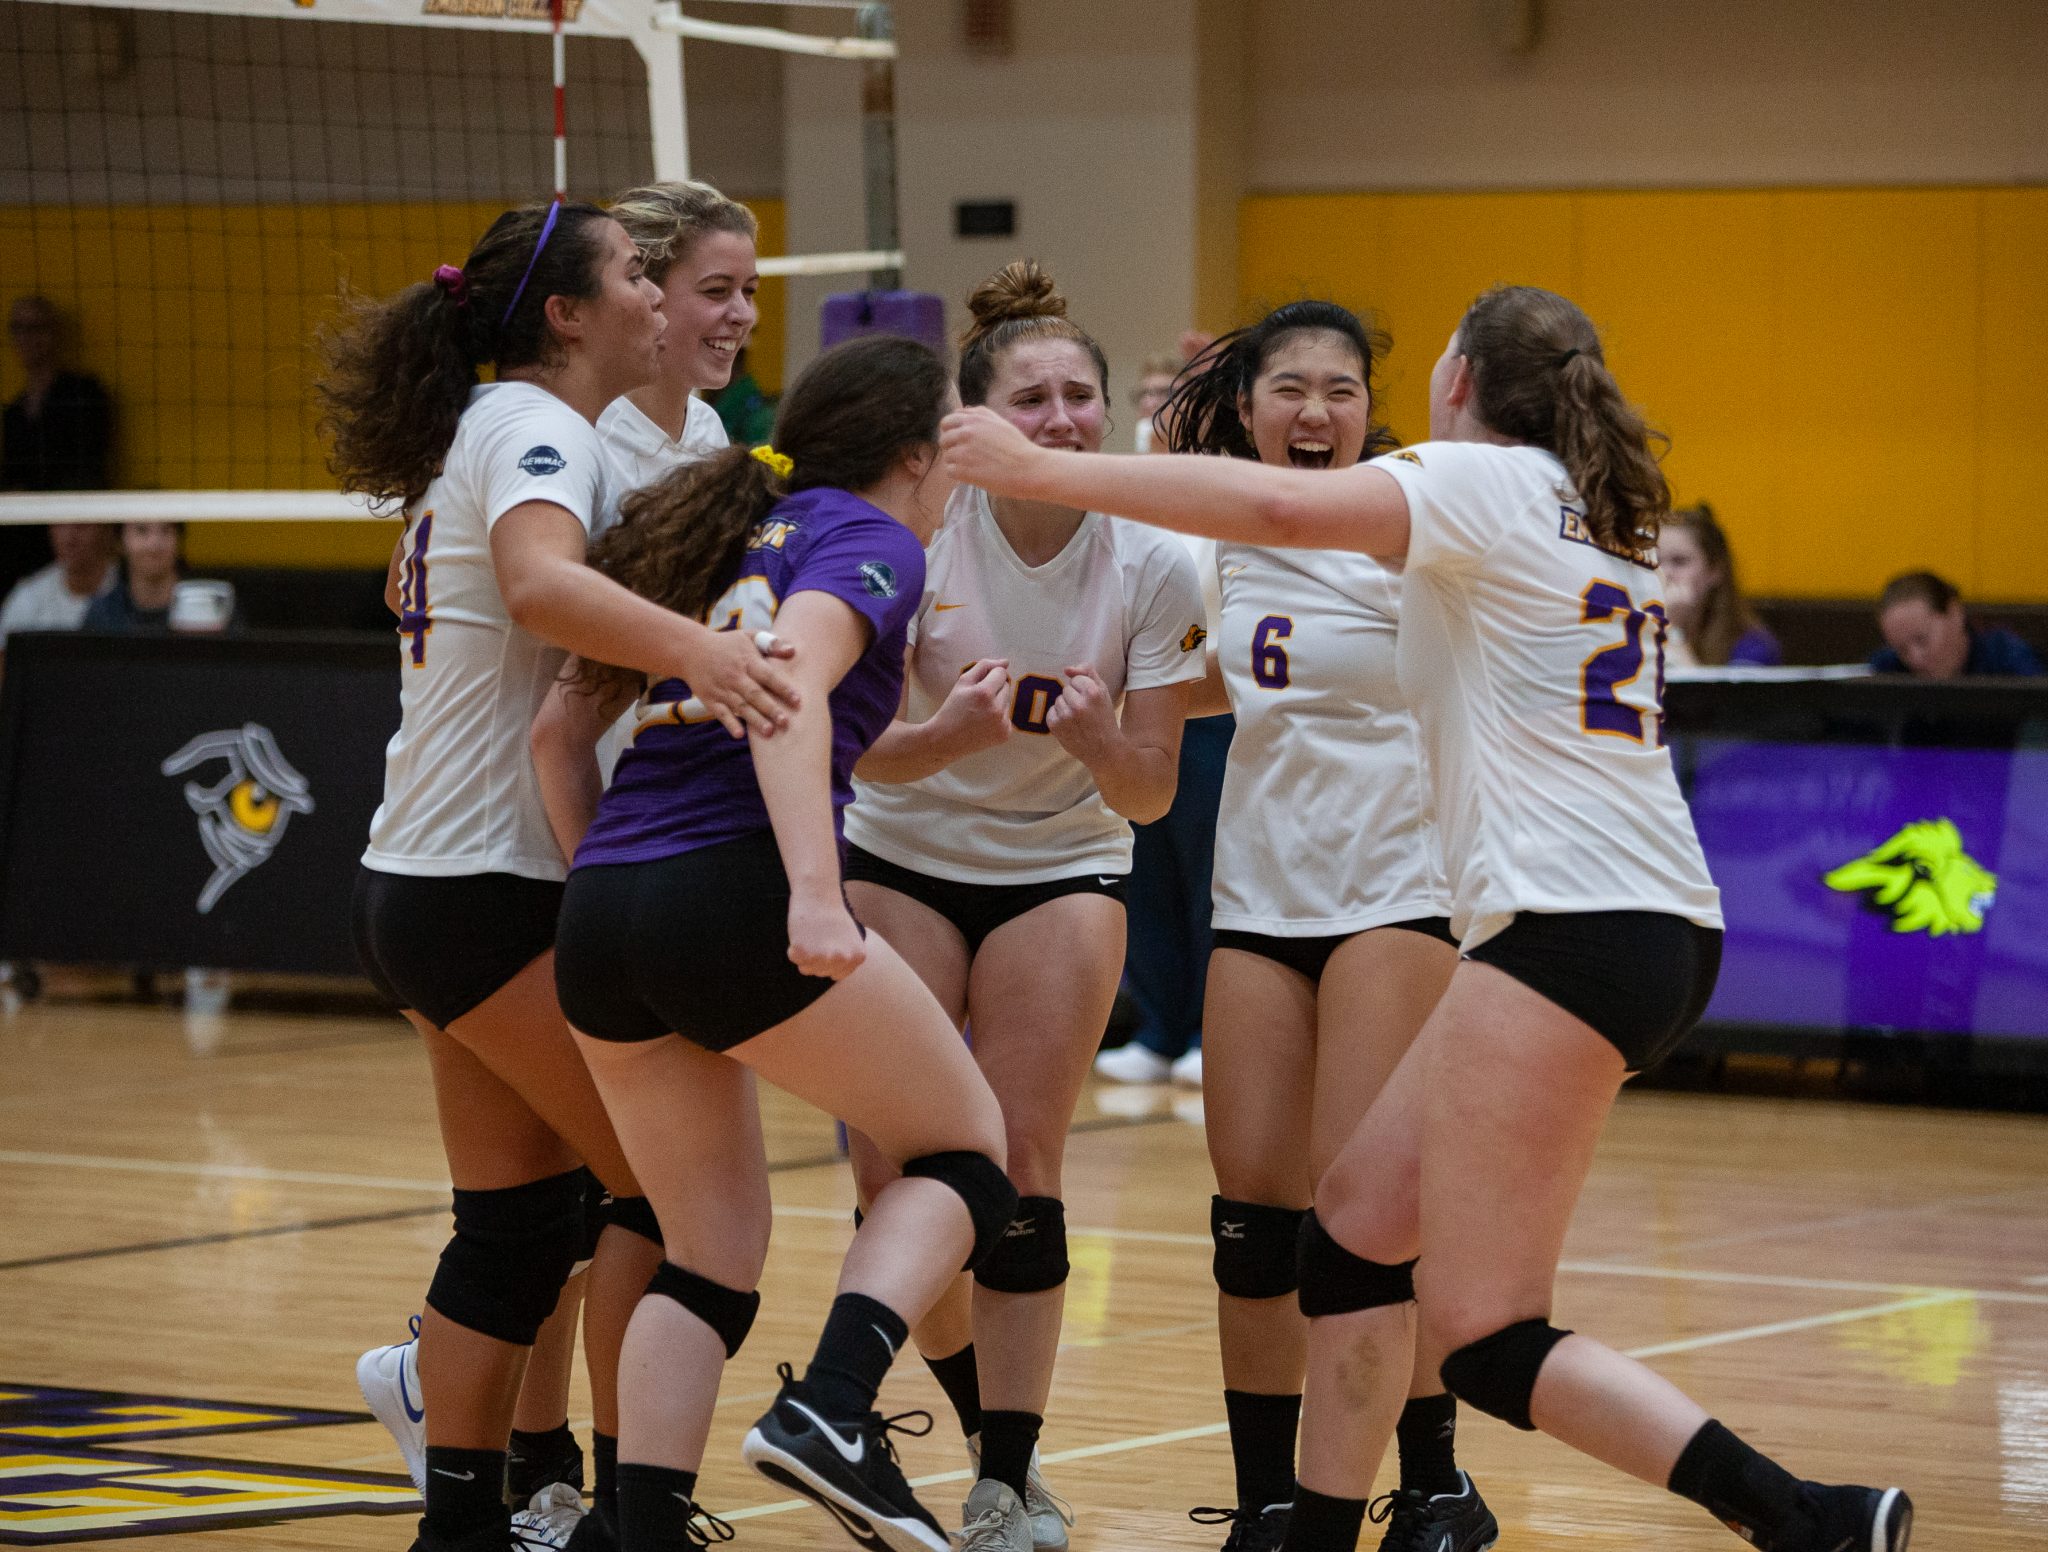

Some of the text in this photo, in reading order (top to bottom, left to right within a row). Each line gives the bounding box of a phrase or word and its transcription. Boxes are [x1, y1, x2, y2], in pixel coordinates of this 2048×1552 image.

[518, 456, 566, 469] NEWMAC
[859, 562, 896, 598] NEWMAC
[1250, 613, 1295, 692] 6
